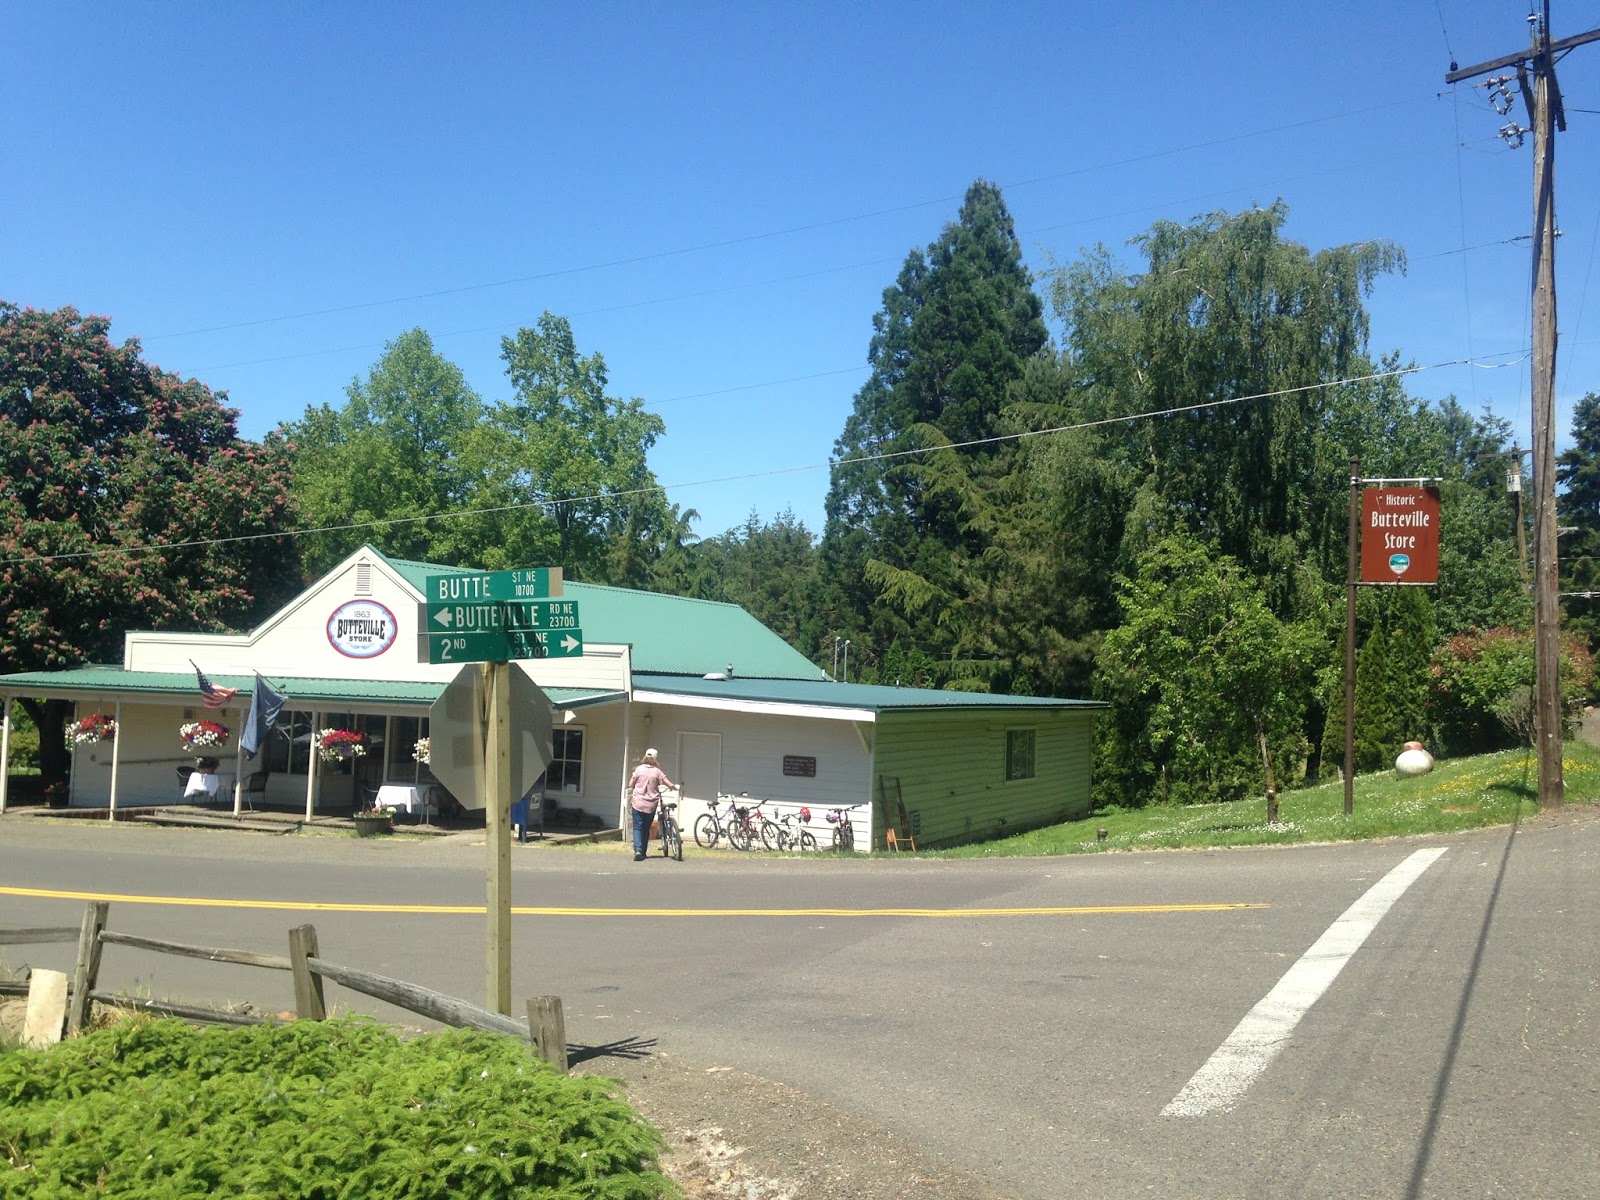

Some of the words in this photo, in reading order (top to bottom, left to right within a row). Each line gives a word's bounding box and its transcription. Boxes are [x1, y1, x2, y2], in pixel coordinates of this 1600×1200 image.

[1385, 494, 1415, 506] Historic
[1371, 510, 1430, 528] Butteville
[1384, 532, 1416, 549] Store
[512, 571, 521, 583] ST
[526, 570, 536, 582] NE
[439, 576, 491, 599] BUTTE
[515, 584, 535, 596] 10700
[353, 610, 371, 618] 1863
[549, 603, 560, 614] RD
[563, 603, 573, 613] NE
[455, 605, 540, 628] BUTTEVILLE
[549, 616, 575, 627] 23700
[336, 618, 386, 641] BUTTEVILLE
[348, 635, 373, 643] STORE
[514, 634, 525, 643] ST
[535, 632, 548, 643] NE
[441, 638, 466, 660] 2ND
[514, 645, 549, 659] 23700
